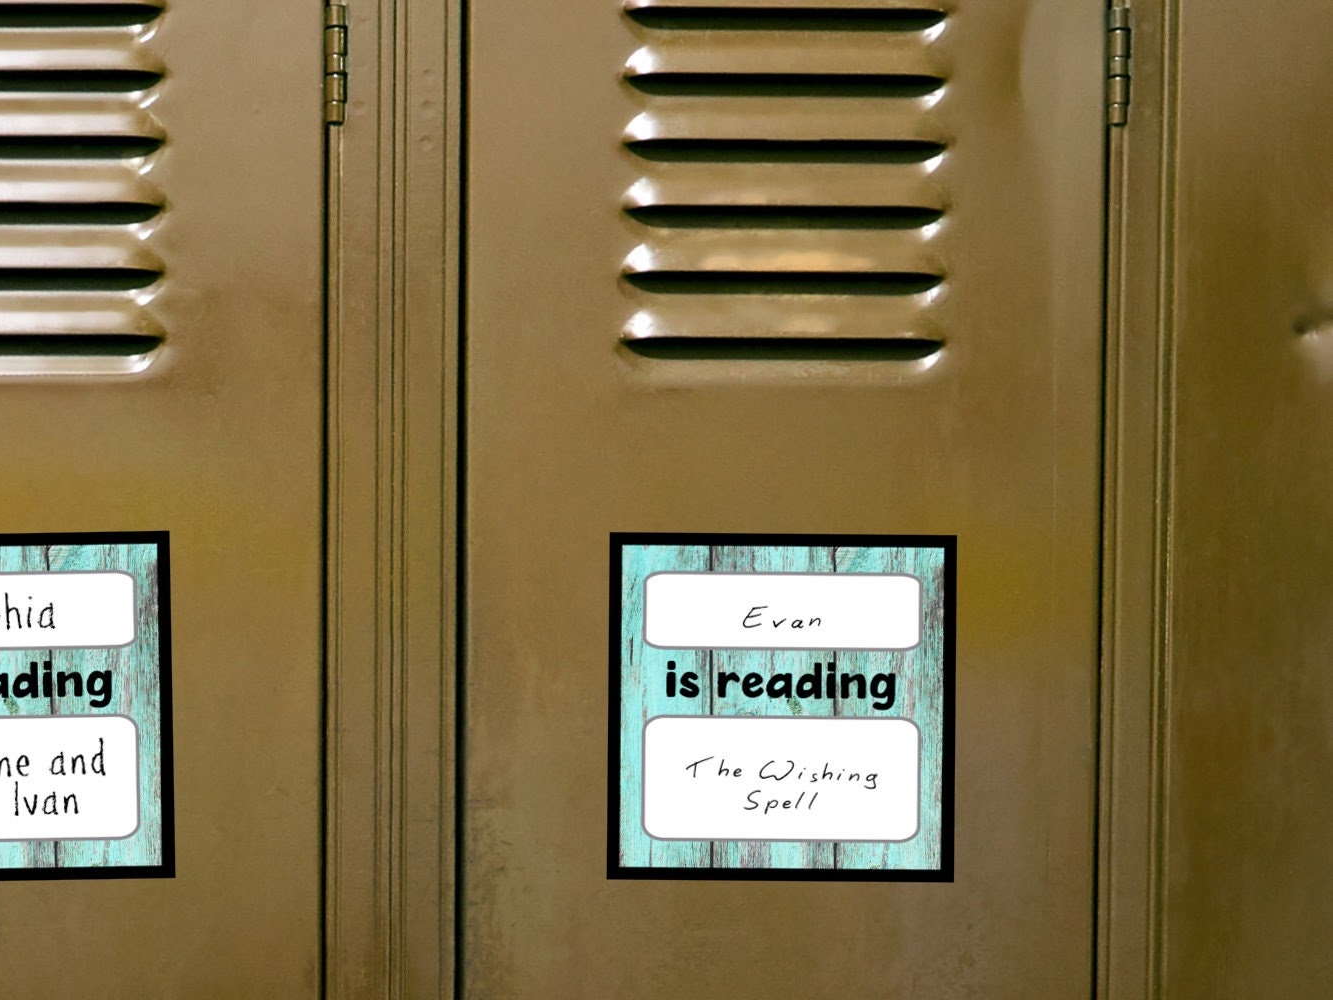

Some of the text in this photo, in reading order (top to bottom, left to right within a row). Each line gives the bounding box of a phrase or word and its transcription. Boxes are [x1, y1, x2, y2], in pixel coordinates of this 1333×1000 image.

[742, 606, 821, 630] Evan
[666, 660, 896, 711] is reading
[49, 737, 106, 777] and
[685, 756, 878, 791] The Wishing
[14, 780, 79, 817] Ivan
[744, 789, 819, 815] Spell
